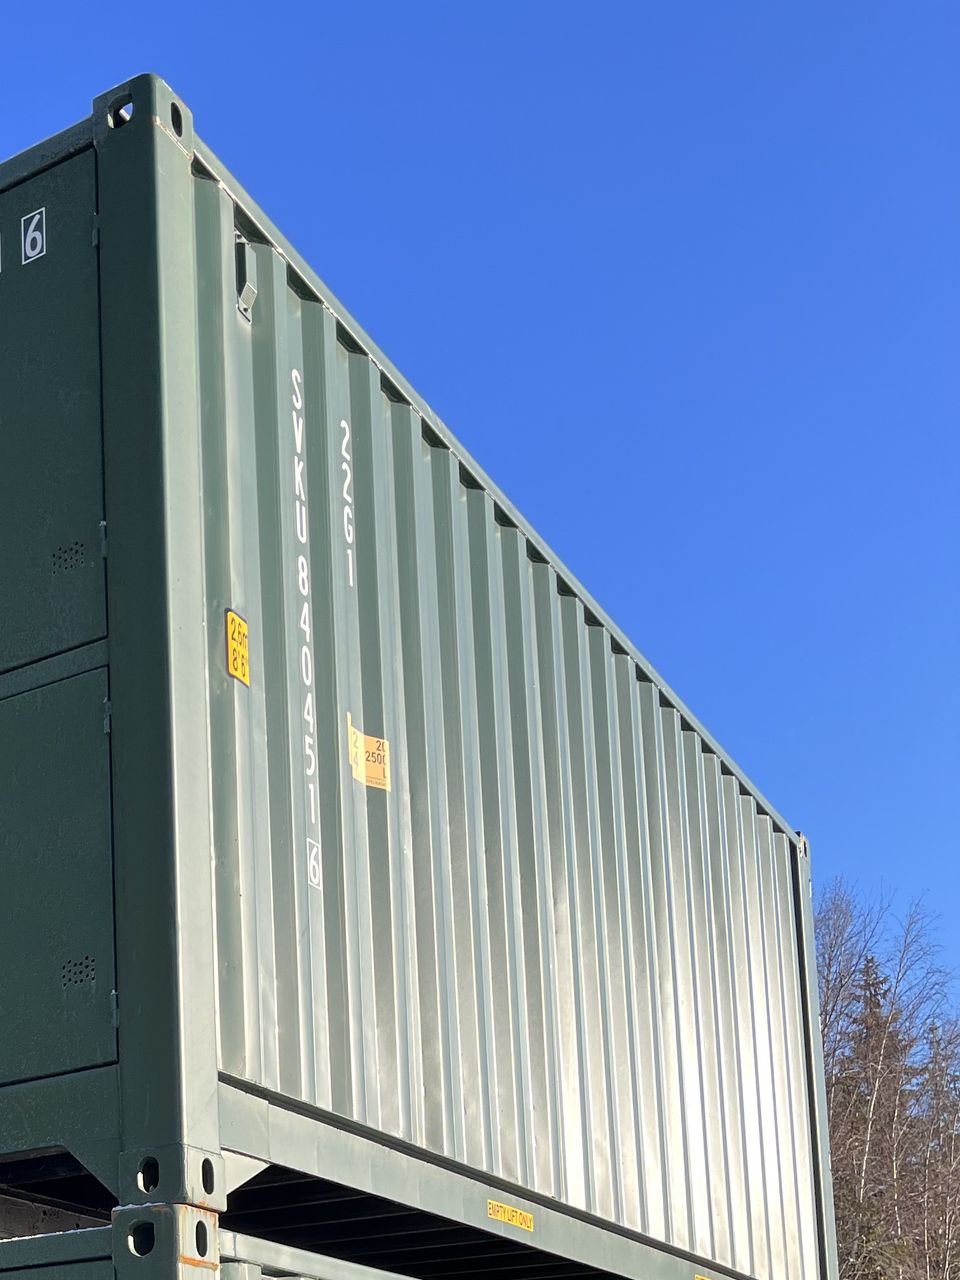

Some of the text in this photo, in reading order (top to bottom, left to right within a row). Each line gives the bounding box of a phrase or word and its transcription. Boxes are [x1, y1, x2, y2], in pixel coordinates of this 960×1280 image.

[24, 213, 43, 258] 6
[340, 419, 354, 587] 22G1
[291, 368, 321, 884] SVKU 840451 6
